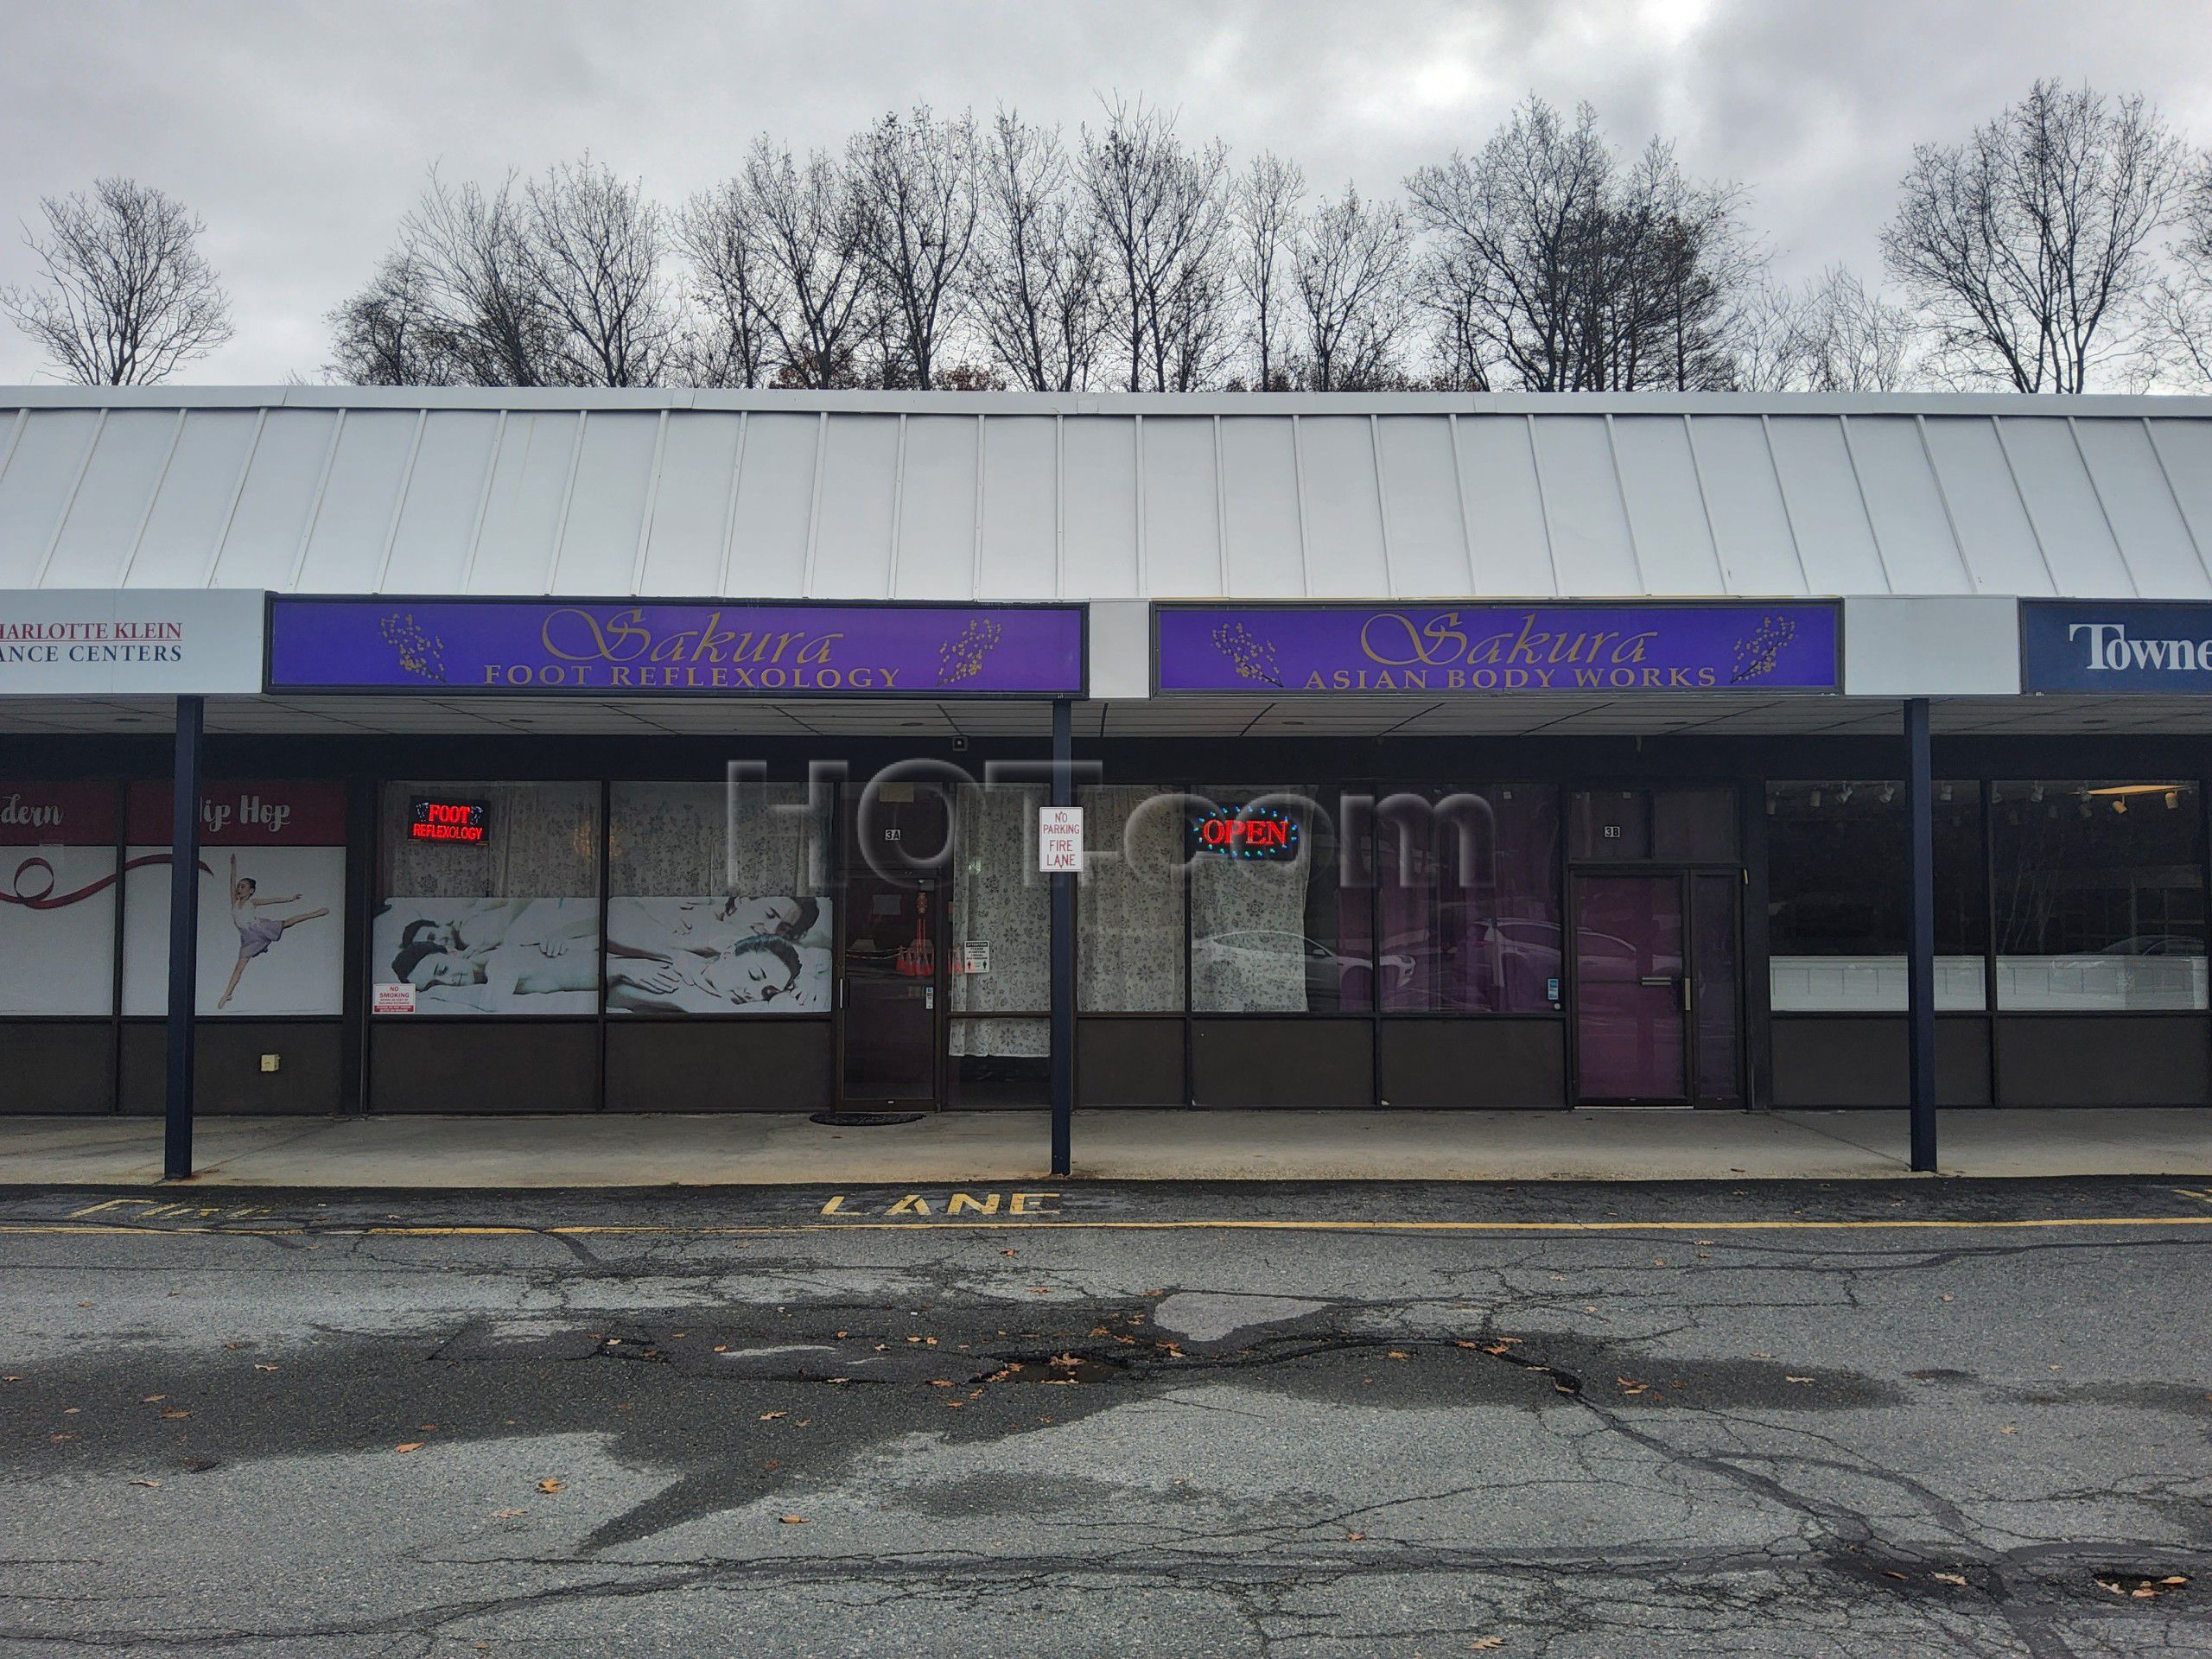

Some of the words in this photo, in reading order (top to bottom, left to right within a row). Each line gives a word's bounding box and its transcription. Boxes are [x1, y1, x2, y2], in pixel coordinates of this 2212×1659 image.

[113, 622, 182, 639] KLEIN
[542, 608, 844, 664] Sakura
[1361, 612, 1658, 665] Sakura
[69, 645, 181, 662] CENTERS
[2069, 624, 2212, 671] Towne
[484, 664, 593, 685] FOOT
[610, 665, 900, 689] REFLEXOLOGY
[1305, 670, 1428, 690] ASIAN
[1447, 669, 1556, 689] BODY
[1573, 667, 1717, 688] WORKS
[200, 795, 231, 831] ip
[239, 795, 290, 832] Hop
[429, 804, 470, 823] FOOT
[1054, 812, 1068, 823] NO
[413, 823, 483, 840] REFLEXOLOGY
[886, 830, 899, 840] 3A
[1043, 823, 1080, 835] PARKING
[1203, 819, 1288, 844] OPEN
[1049, 839, 1073, 852] FIRE
[1046, 854, 1076, 867] LANE
[821, 1193, 1061, 1216] LANE
